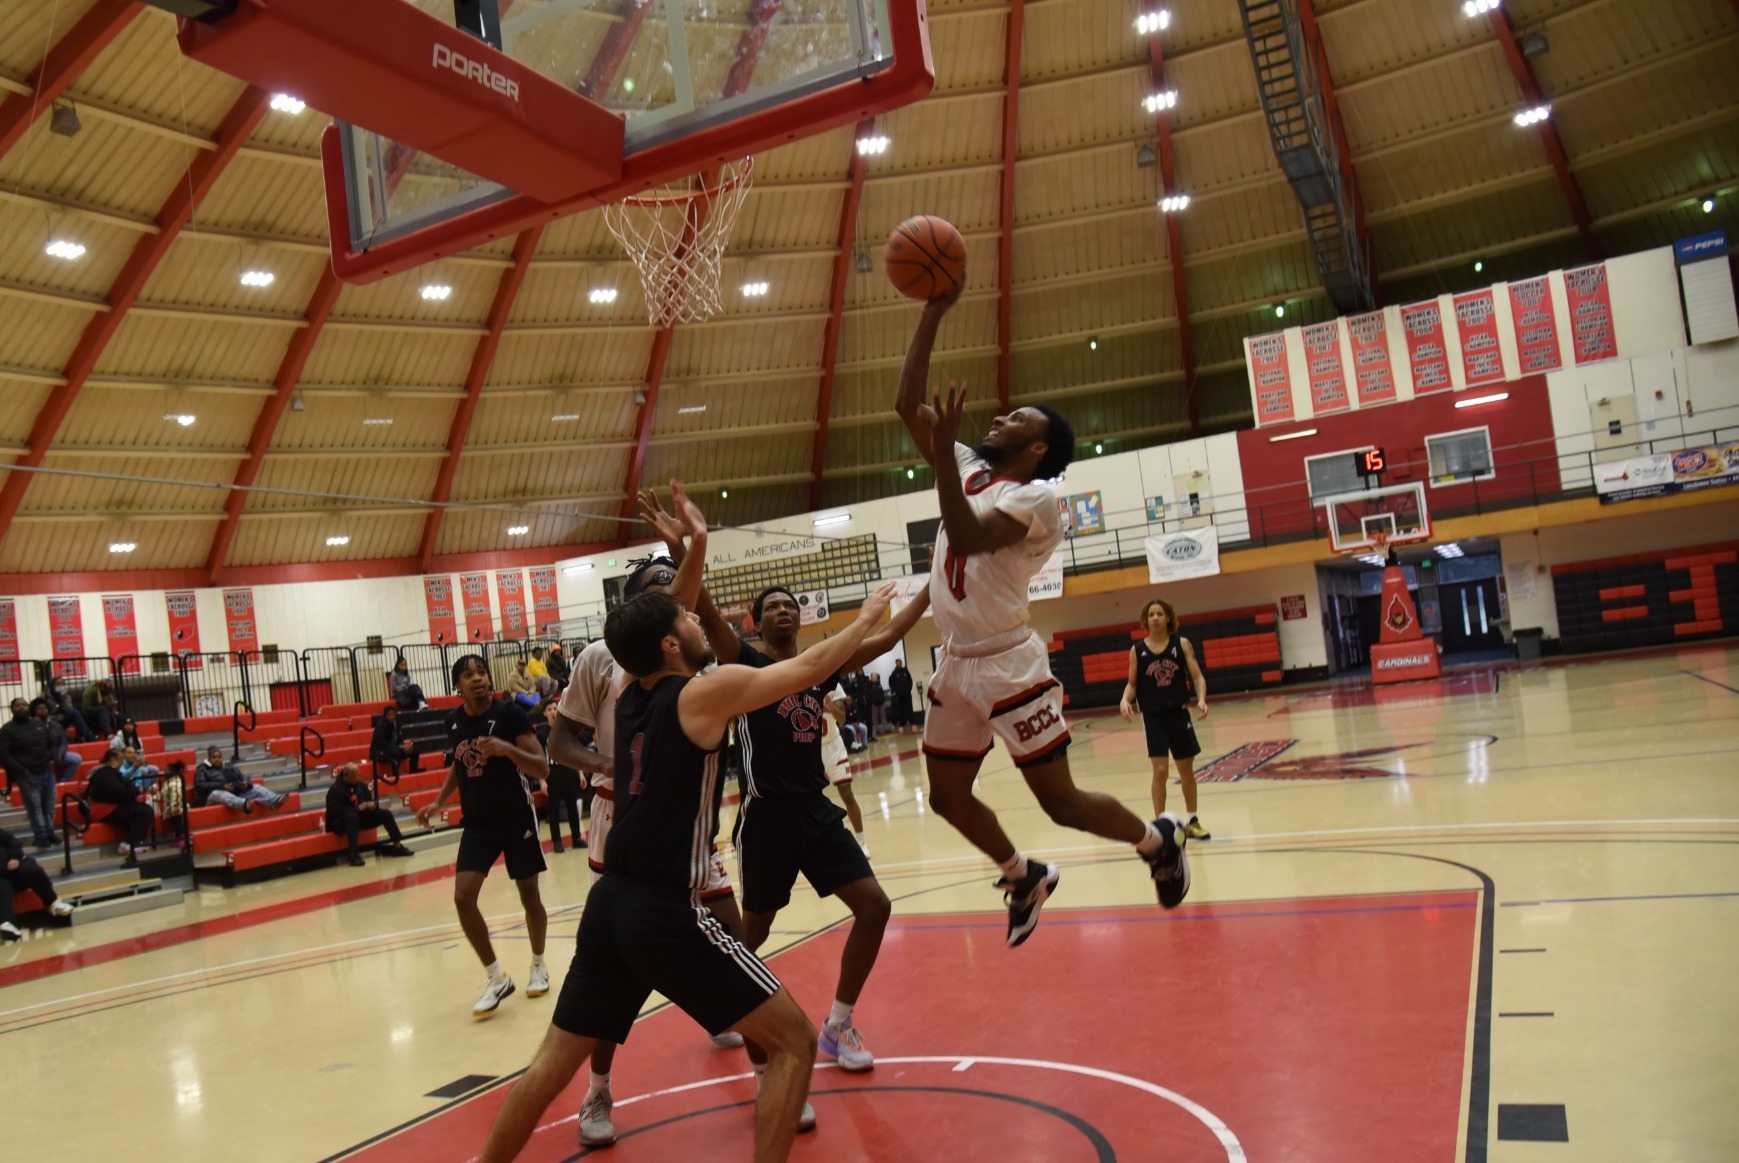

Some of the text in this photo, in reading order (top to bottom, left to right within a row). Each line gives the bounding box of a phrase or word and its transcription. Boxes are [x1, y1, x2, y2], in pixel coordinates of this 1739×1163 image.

[1694, 237, 1725, 251] PEPSI
[1364, 450, 1383, 471] 15
[713, 537, 815, 565] ALL AMERICANS
[1029, 582, 1062, 594] 66-4030
[1377, 654, 1431, 670] CARDINALS
[488, 720, 496, 735] 7
[1013, 704, 1060, 743] BCCC
[630, 732, 644, 795] 1
